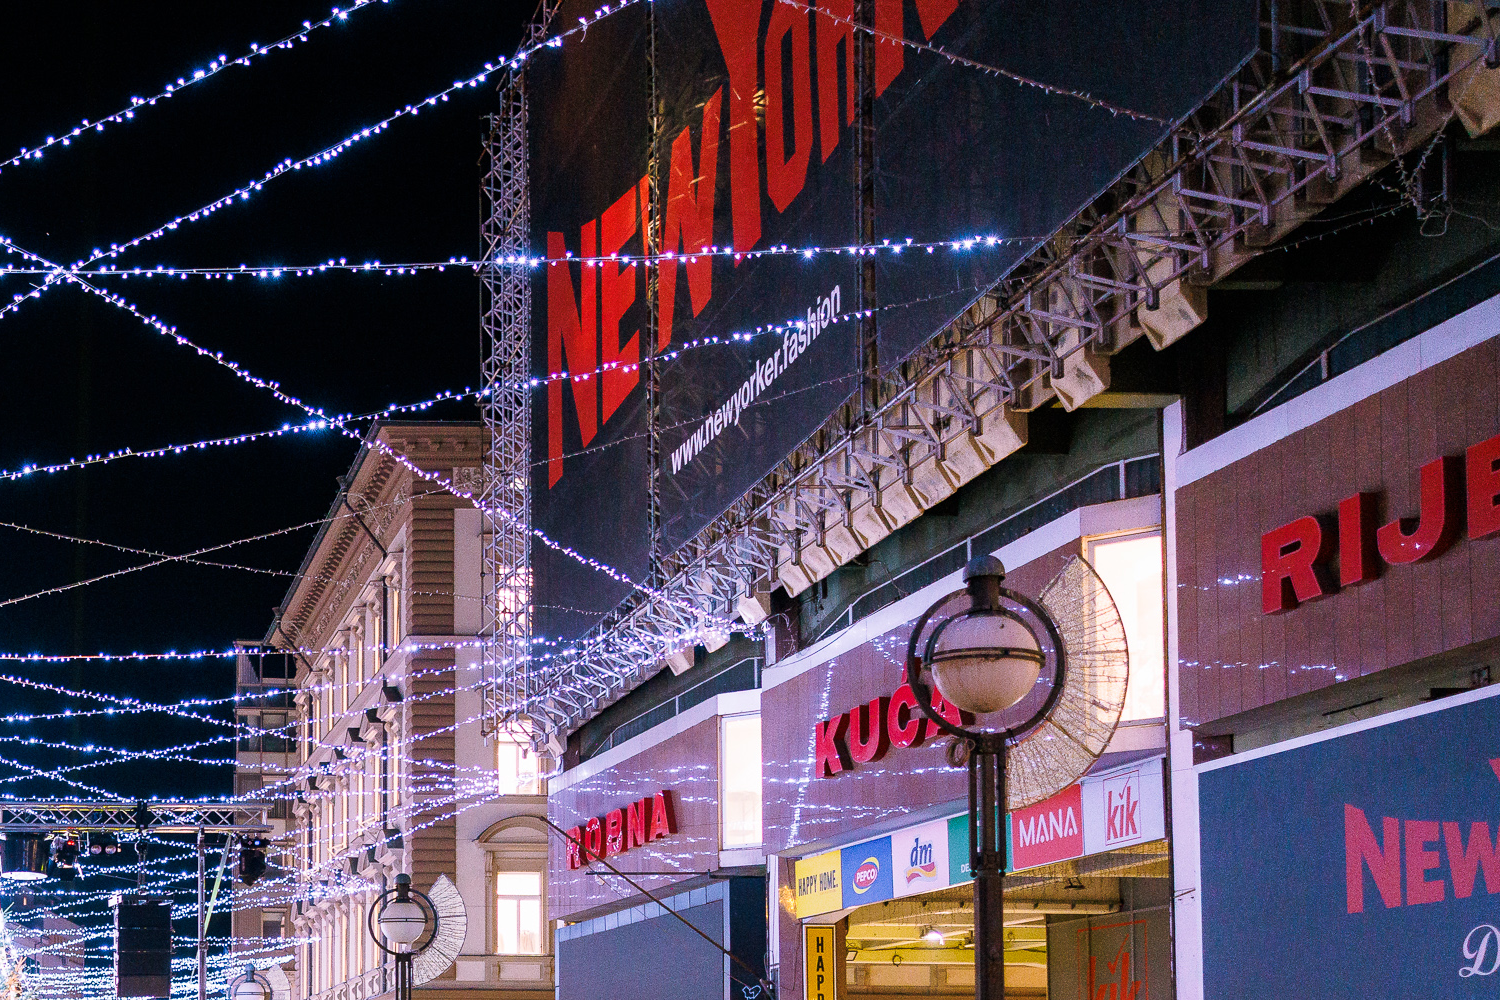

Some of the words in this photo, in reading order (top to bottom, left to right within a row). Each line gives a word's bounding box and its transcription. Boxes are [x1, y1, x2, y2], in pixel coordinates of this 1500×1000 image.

[671, 284, 841, 475] www.newyorker.fashion
[1019, 806, 1078, 848] MANA
[1107, 776, 1139, 841] kik
[566, 790, 671, 871] ROBNA
[910, 838, 933, 868] dm
[798, 874, 818, 897] HAPPY
[856, 868, 876, 883] PEPCO
